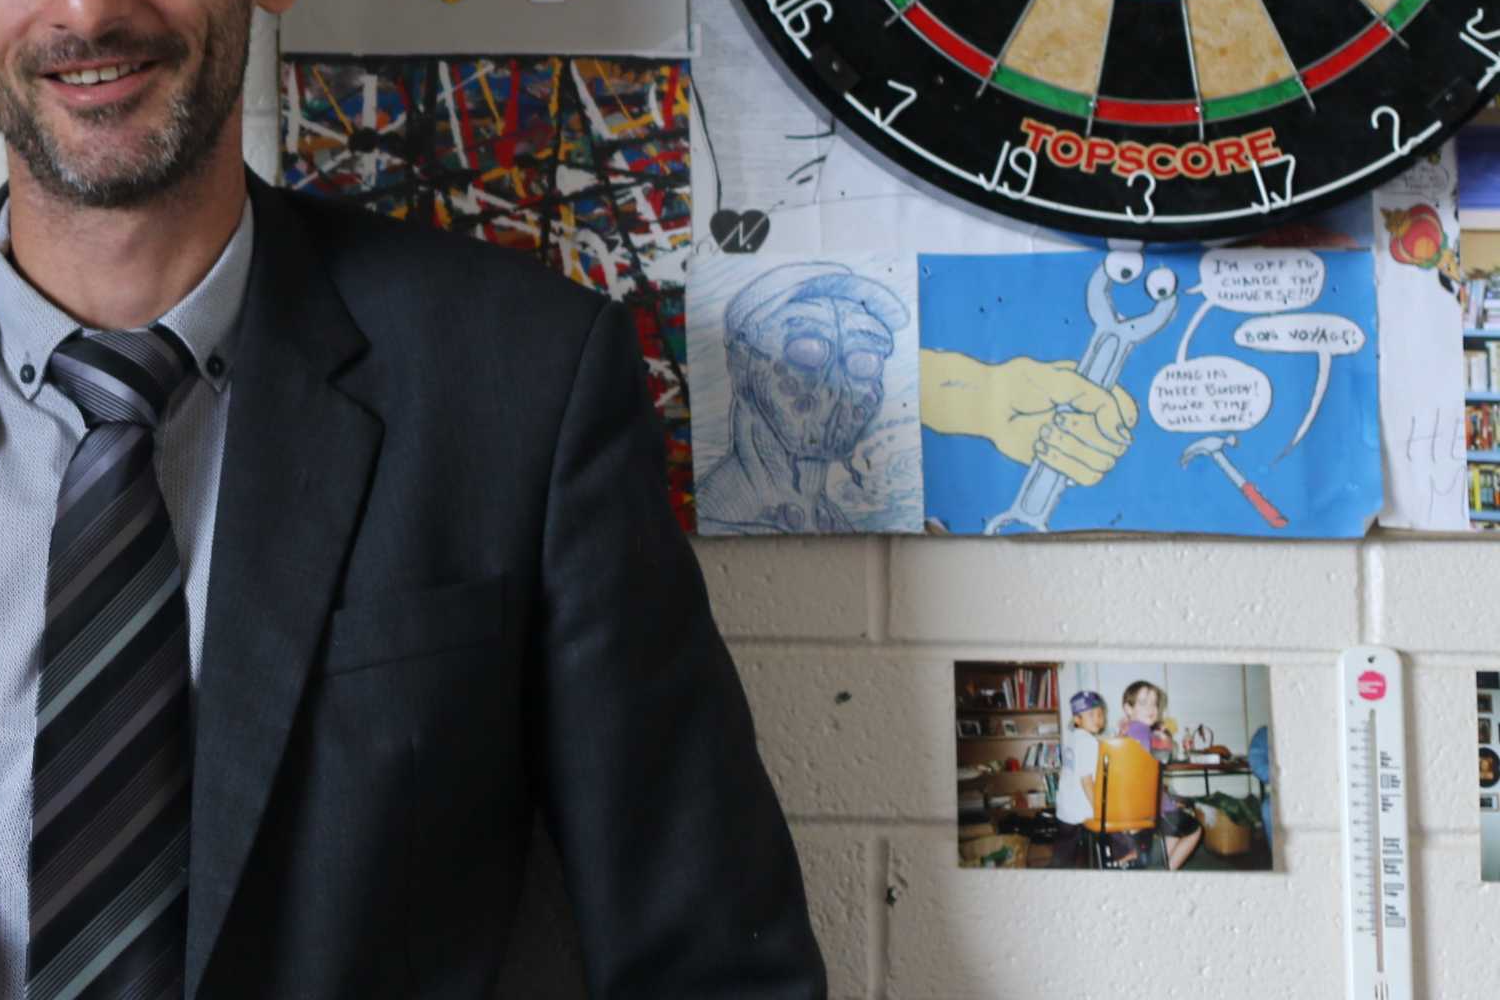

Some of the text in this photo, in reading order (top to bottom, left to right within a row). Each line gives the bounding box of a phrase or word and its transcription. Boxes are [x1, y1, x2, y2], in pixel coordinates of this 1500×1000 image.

[873, 78, 918, 129] 7
[1020, 116, 1285, 181] TOPSCORE
[1371, 104, 1412, 157] 2
[990, 139, 1037, 199] 19
[1251, 154, 1297, 214] 17
[1125, 169, 1157, 223] 3
[1220, 275, 1280, 288] CHANGE
[1253, 259, 1285, 273] OFF
